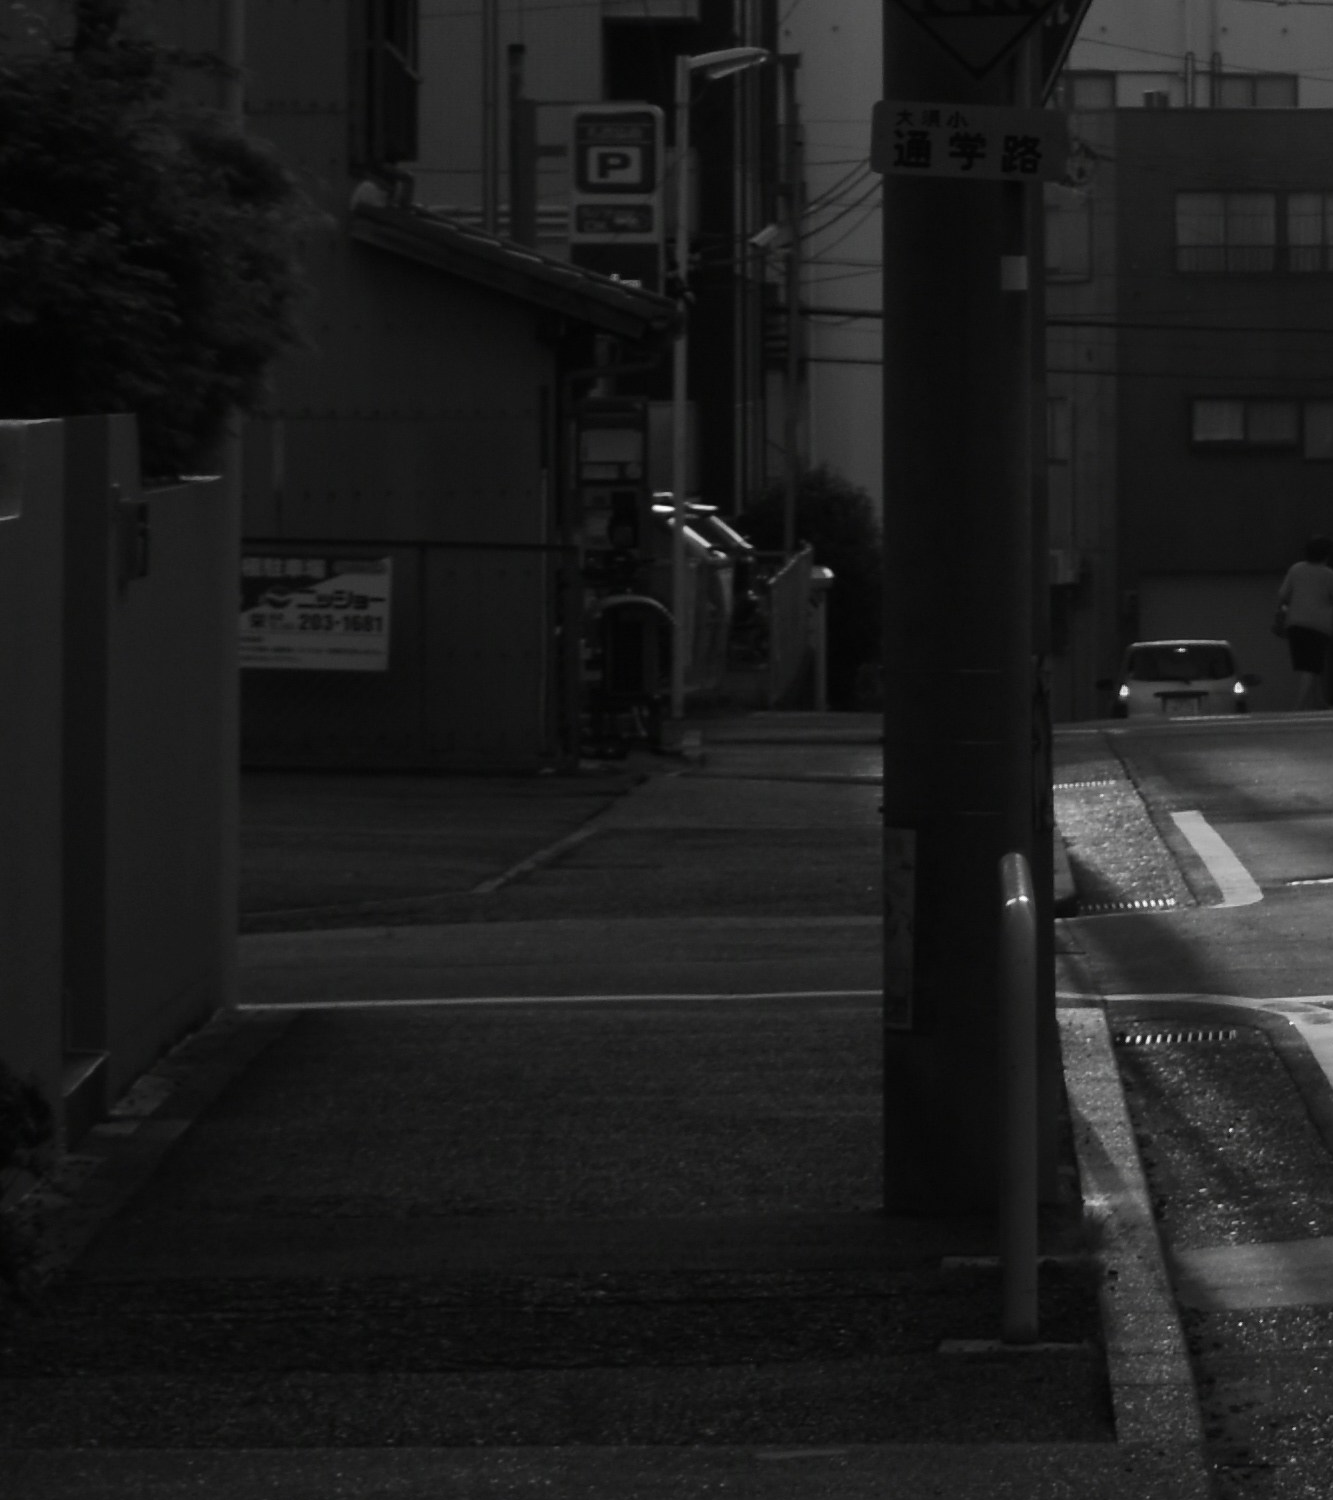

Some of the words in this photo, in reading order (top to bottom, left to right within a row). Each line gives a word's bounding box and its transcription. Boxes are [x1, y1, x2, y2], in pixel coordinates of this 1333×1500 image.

[895, 109, 969, 128] 大須小
[597, 152, 631, 179] P
[893, 130, 1043, 174] 通学路
